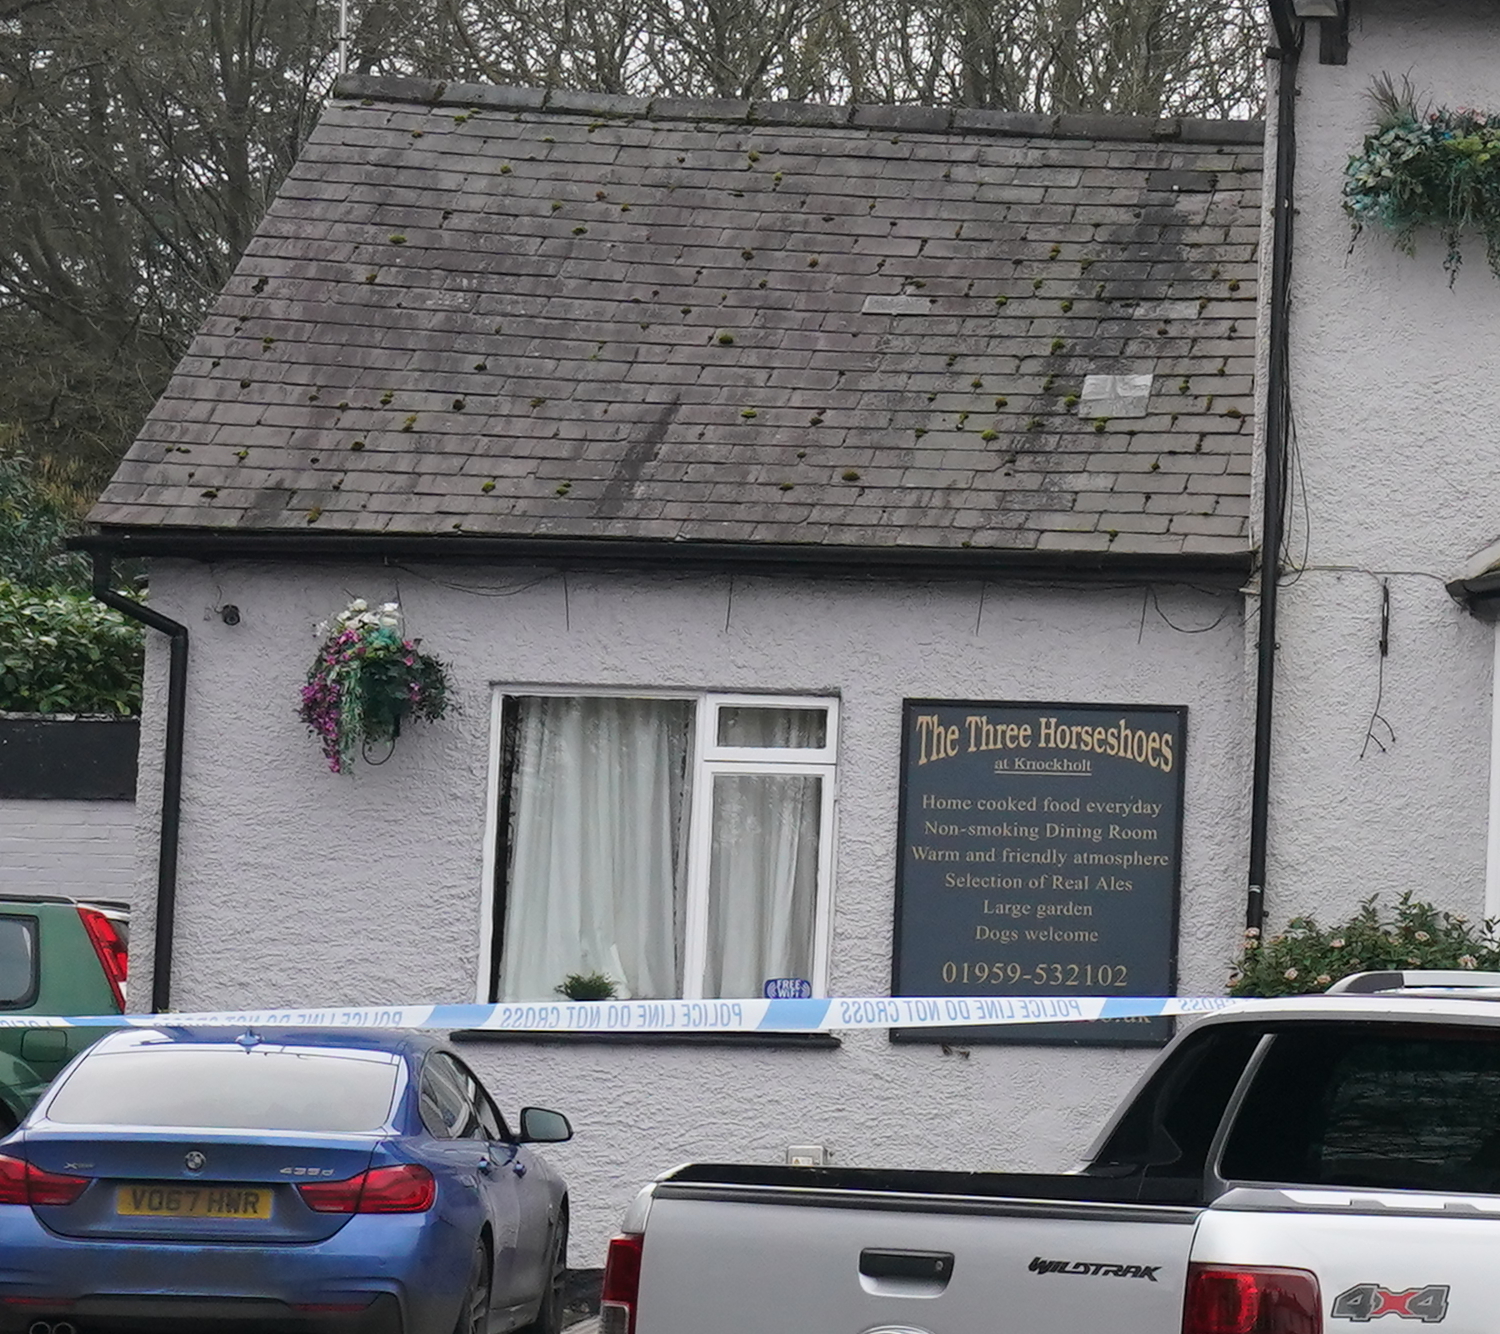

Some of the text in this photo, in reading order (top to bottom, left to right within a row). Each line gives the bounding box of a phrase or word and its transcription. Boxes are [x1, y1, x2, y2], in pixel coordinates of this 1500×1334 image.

[916, 714, 1174, 774] The Three Horseshoes
[994, 757, 1092, 772] at Knockholt
[922, 794, 1162, 817] Home cooked food everyday
[924, 820, 1158, 843] Non-smoking Dining Room
[911, 845, 1169, 868] Warm and friendly atmosphere
[945, 873, 1133, 892] Selection of Real Ales
[983, 899, 1093, 918] Large garden
[975, 924, 1099, 943] Dogs welcome
[776, 979, 802, 990] FREE
[942, 962, 1129, 987] 01959-532102
[206, 1190, 260, 1215] HWR
[1027, 1255, 1164, 1283] WILDTRAK
